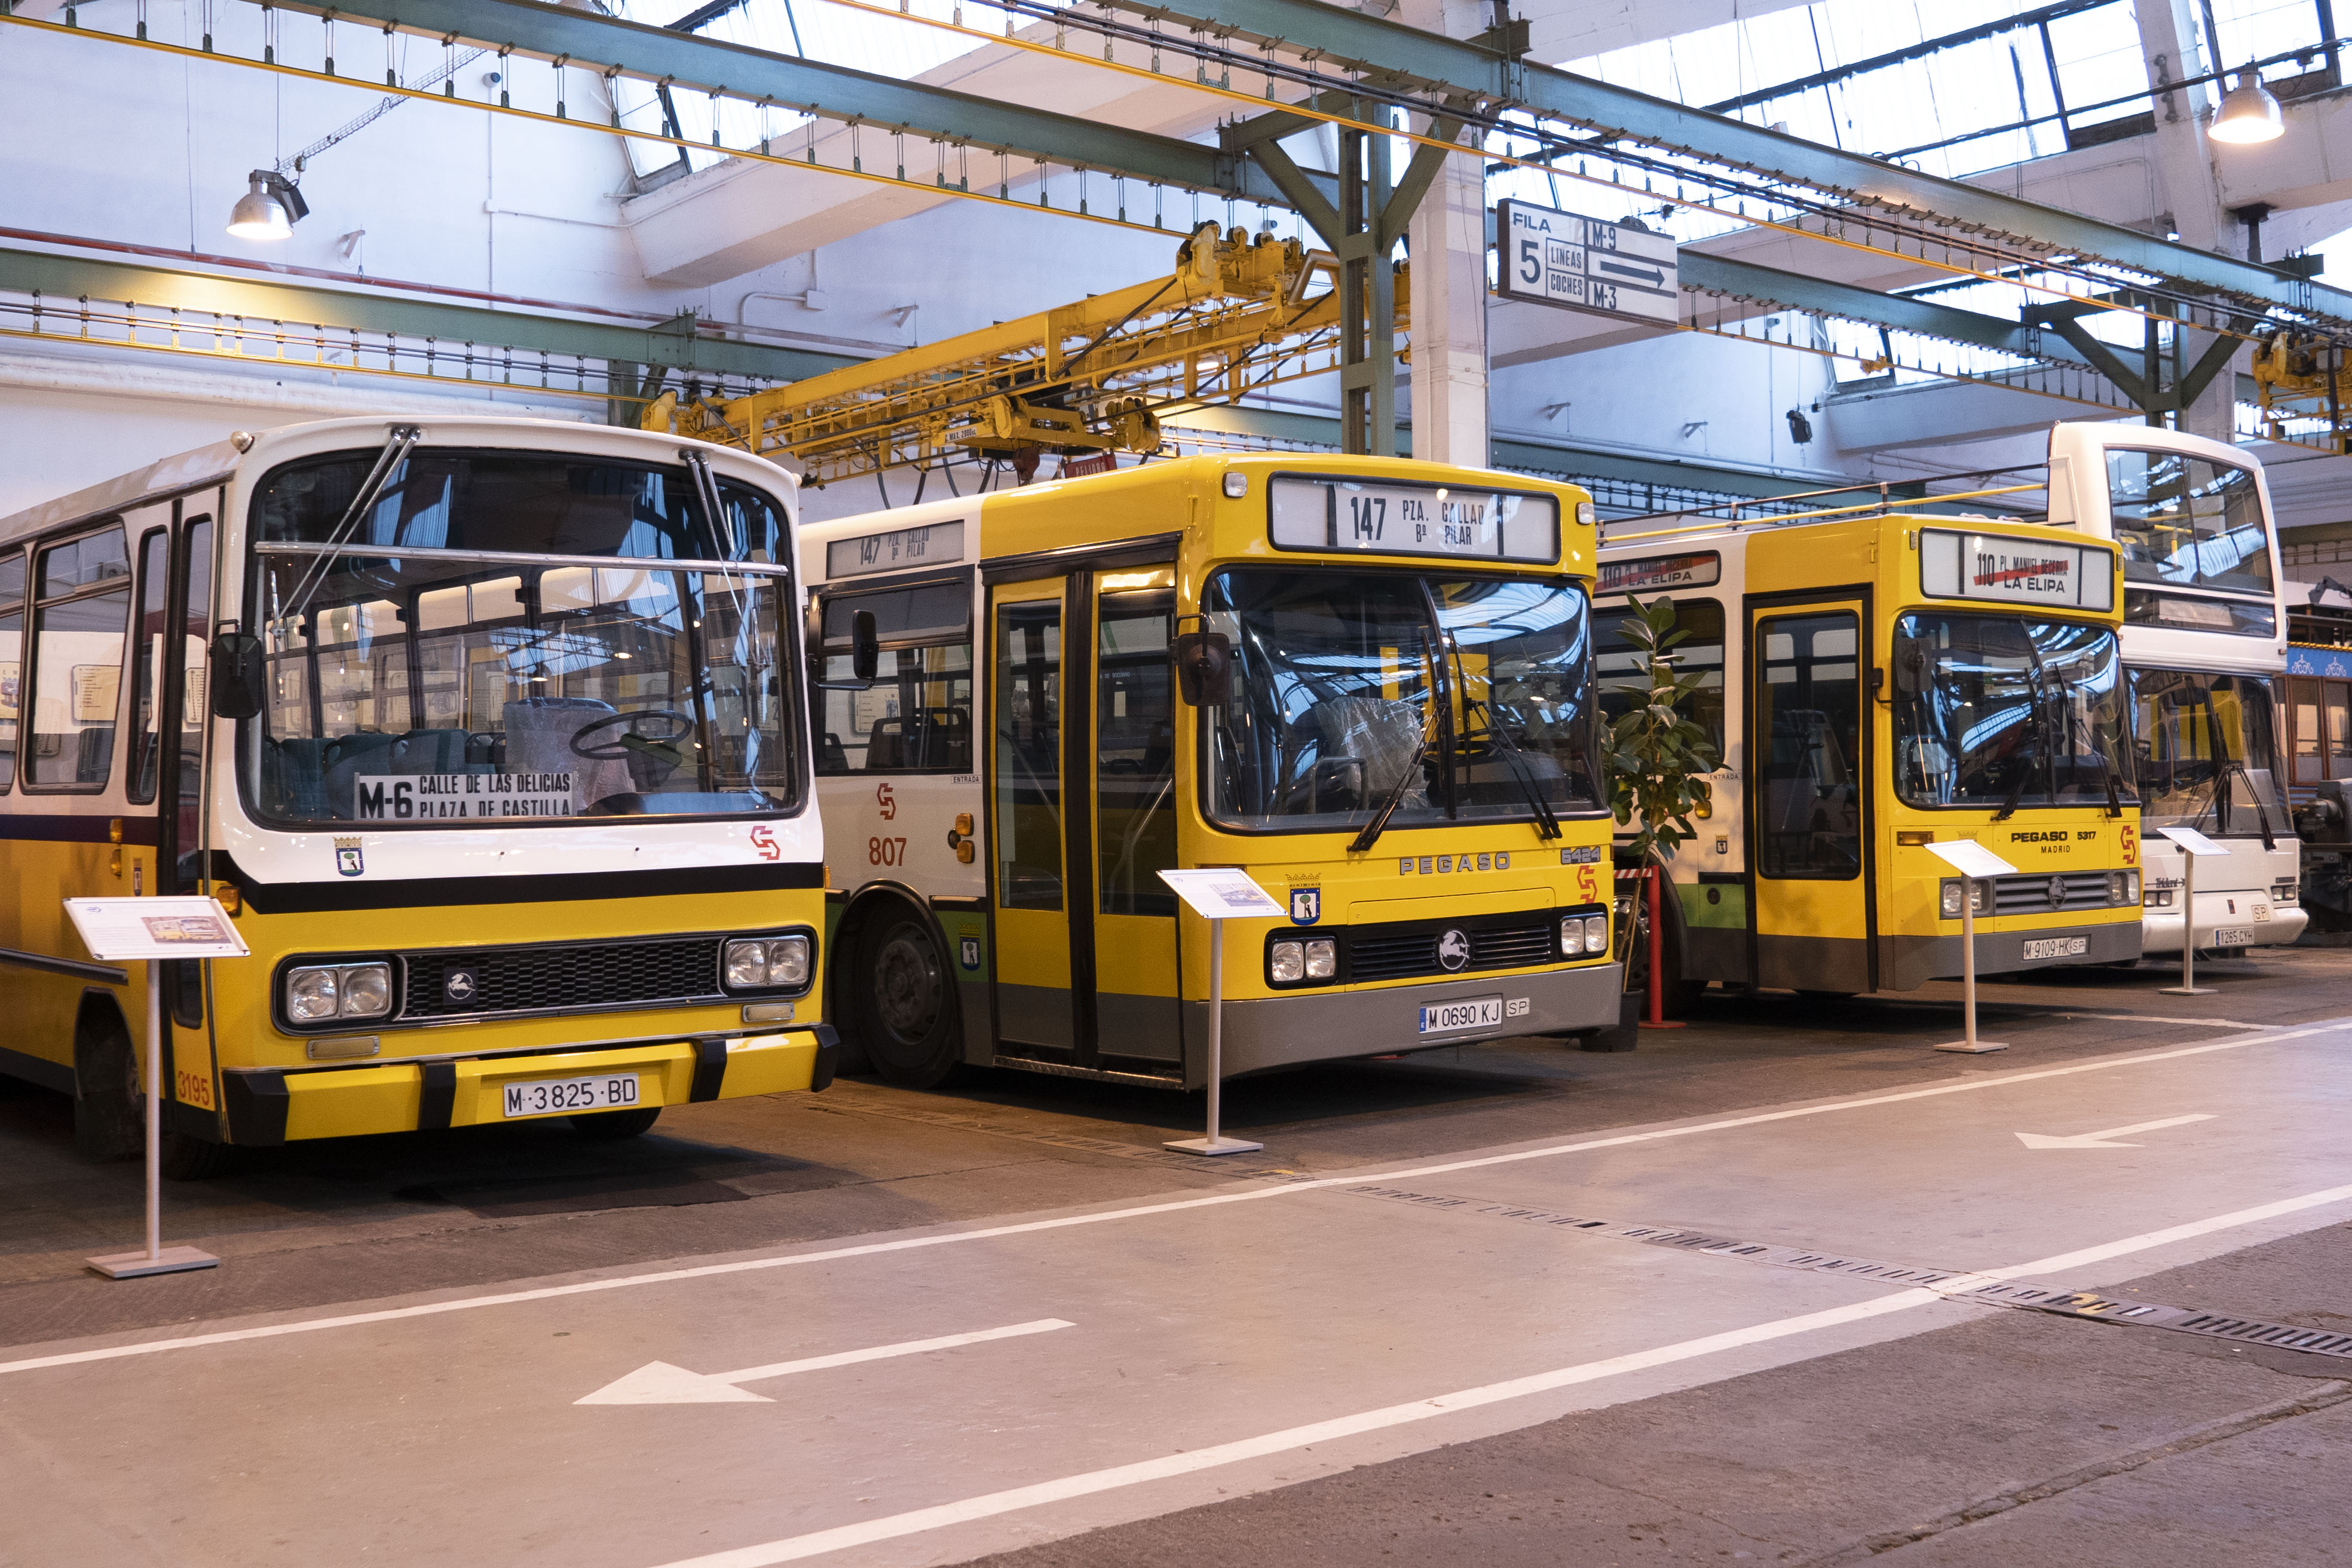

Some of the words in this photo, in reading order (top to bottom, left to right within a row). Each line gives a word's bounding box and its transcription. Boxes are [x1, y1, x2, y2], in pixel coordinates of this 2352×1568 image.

[1513, 212, 1551, 233] FILA
[1592, 222, 1616, 251] M-9
[1520, 240, 1541, 284] 5
[1551, 246, 1581, 269] LINEAS
[1551, 274, 1582, 296] COCHES
[1593, 283, 1616, 310] M-3
[1076, 462, 1105, 477] PELIGRO
[1350, 497, 1387, 541] 147
[1403, 500, 1429, 522] PZA.
[1441, 502, 1484, 526] CALLAO
[1444, 525, 1472, 546] PILAR
[860, 537, 881, 565] 147
[906, 543, 925, 558] PILAR
[1977, 553, 1995, 586] 110
[2013, 556, 2038, 574] MANUEL
[1603, 565, 1622, 589] 110
[1628, 577, 1646, 586] LA
[1652, 571, 1692, 584] ELIPA
[2004, 575, 2022, 590] LA
[2028, 577, 2065, 593] ELIPA
[419, 775, 458, 794] CALLE
[466, 774, 480, 794] DE
[489, 774, 512, 793] LAS
[517, 773, 569, 792] DELICIAS
[360, 782, 413, 819] M-6
[420, 801, 467, 818] PLAZA
[479, 800, 494, 816] DE
[503, 799, 569, 816] CASTILLA
[2011, 831, 2068, 843] PEGASO
[2077, 831, 2097, 840] 5317
[869, 837, 906, 866] 807
[1561, 846, 1600, 865] 6424
[2041, 845, 2071, 854] MADRID
[1399, 852, 1511, 875] PEGASO
[2254, 906, 2267, 920] SP
[2073, 941, 2084, 951] SP
[2221, 930, 2237, 944] 1265
[2239, 929, 2253, 942] CYH
[1429, 1009, 1437, 1028] M
[1442, 1005, 1476, 1027] 0690
[1508, 1001, 1527, 1014] SP
[179, 1071, 210, 1105] 3195
